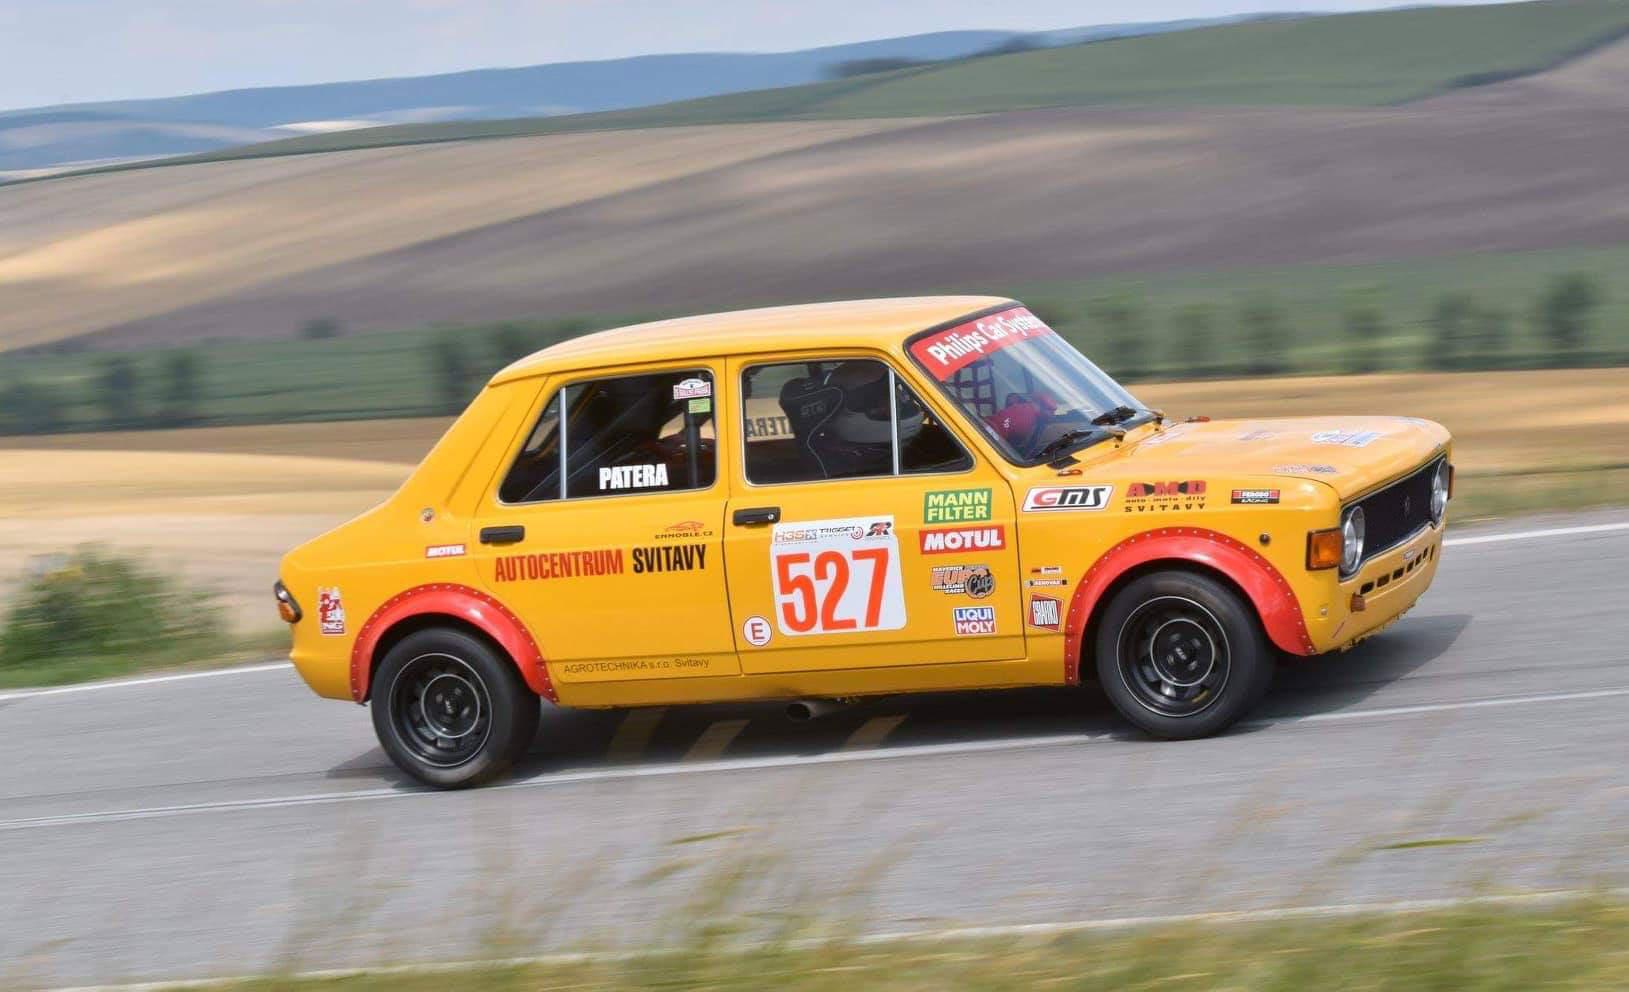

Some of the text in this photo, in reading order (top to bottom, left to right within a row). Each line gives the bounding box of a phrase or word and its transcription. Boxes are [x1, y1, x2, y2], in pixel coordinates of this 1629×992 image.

[976, 320, 1009, 340] Car
[599, 463, 669, 490] PATERA
[928, 490, 989, 507] MANN
[927, 505, 989, 522] FILTER
[1125, 503, 1206, 513] SVITAVY
[923, 527, 1002, 551] MOTUL
[494, 544, 706, 583] AUTOCENTRUM SVITAVY
[776, 547, 889, 633] 527
[955, 608, 993, 622] LIQUI
[751, 623, 764, 641] E
[956, 621, 994, 634] MOLY
[564, 661, 649, 674] AGROTECHNIKA
[675, 658, 711, 669] Svitavy
